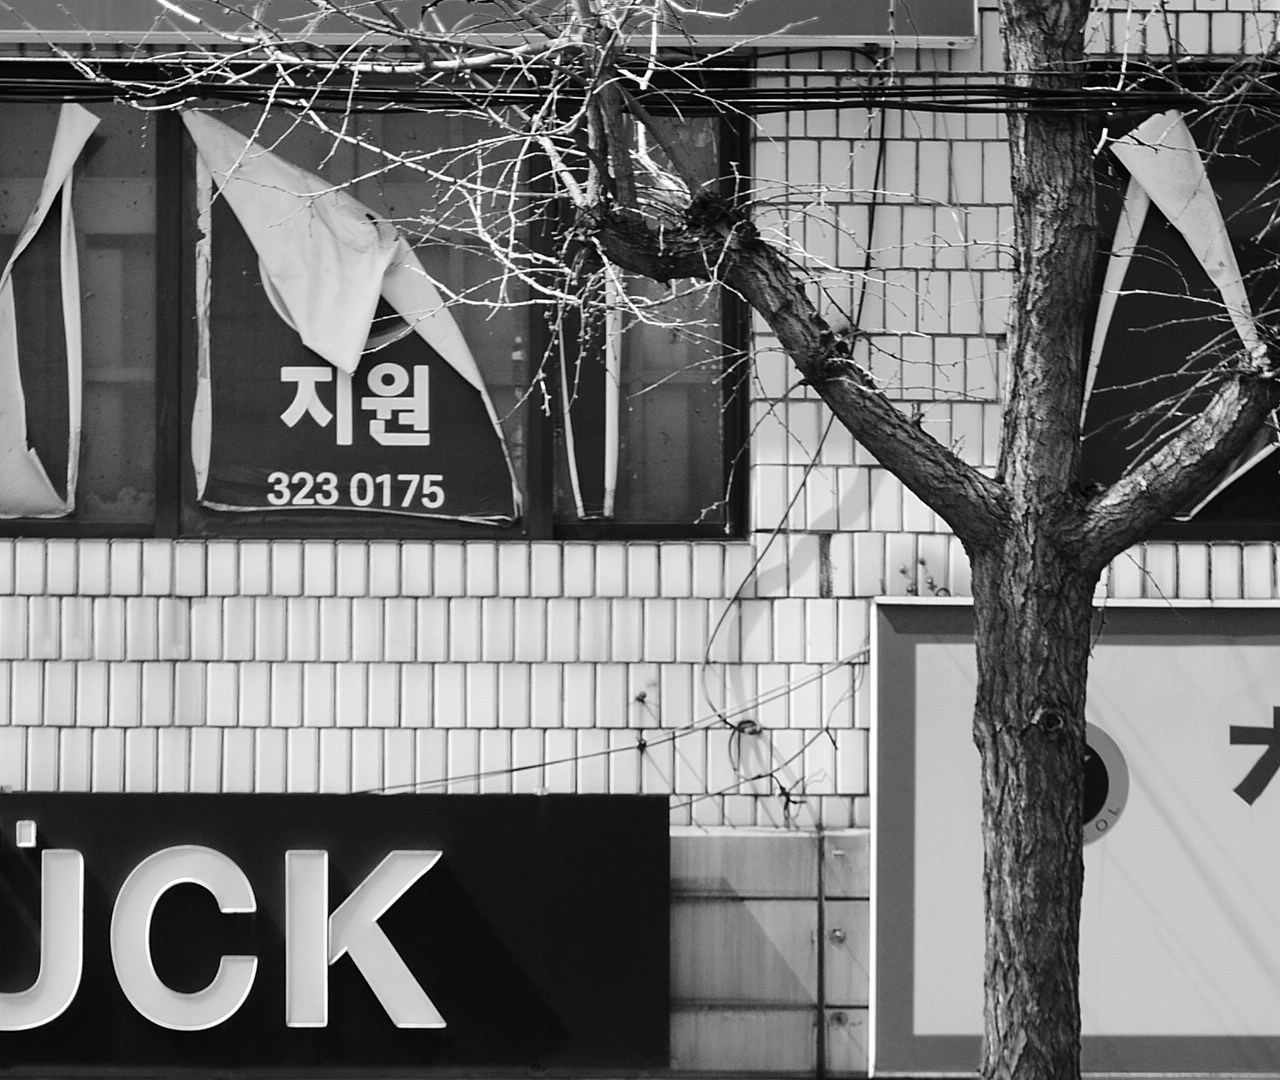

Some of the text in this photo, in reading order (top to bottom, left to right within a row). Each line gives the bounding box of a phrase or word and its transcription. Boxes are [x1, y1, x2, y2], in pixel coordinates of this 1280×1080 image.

[280, 362, 431, 447] 지원
[266, 471, 446, 509] 323 0175
